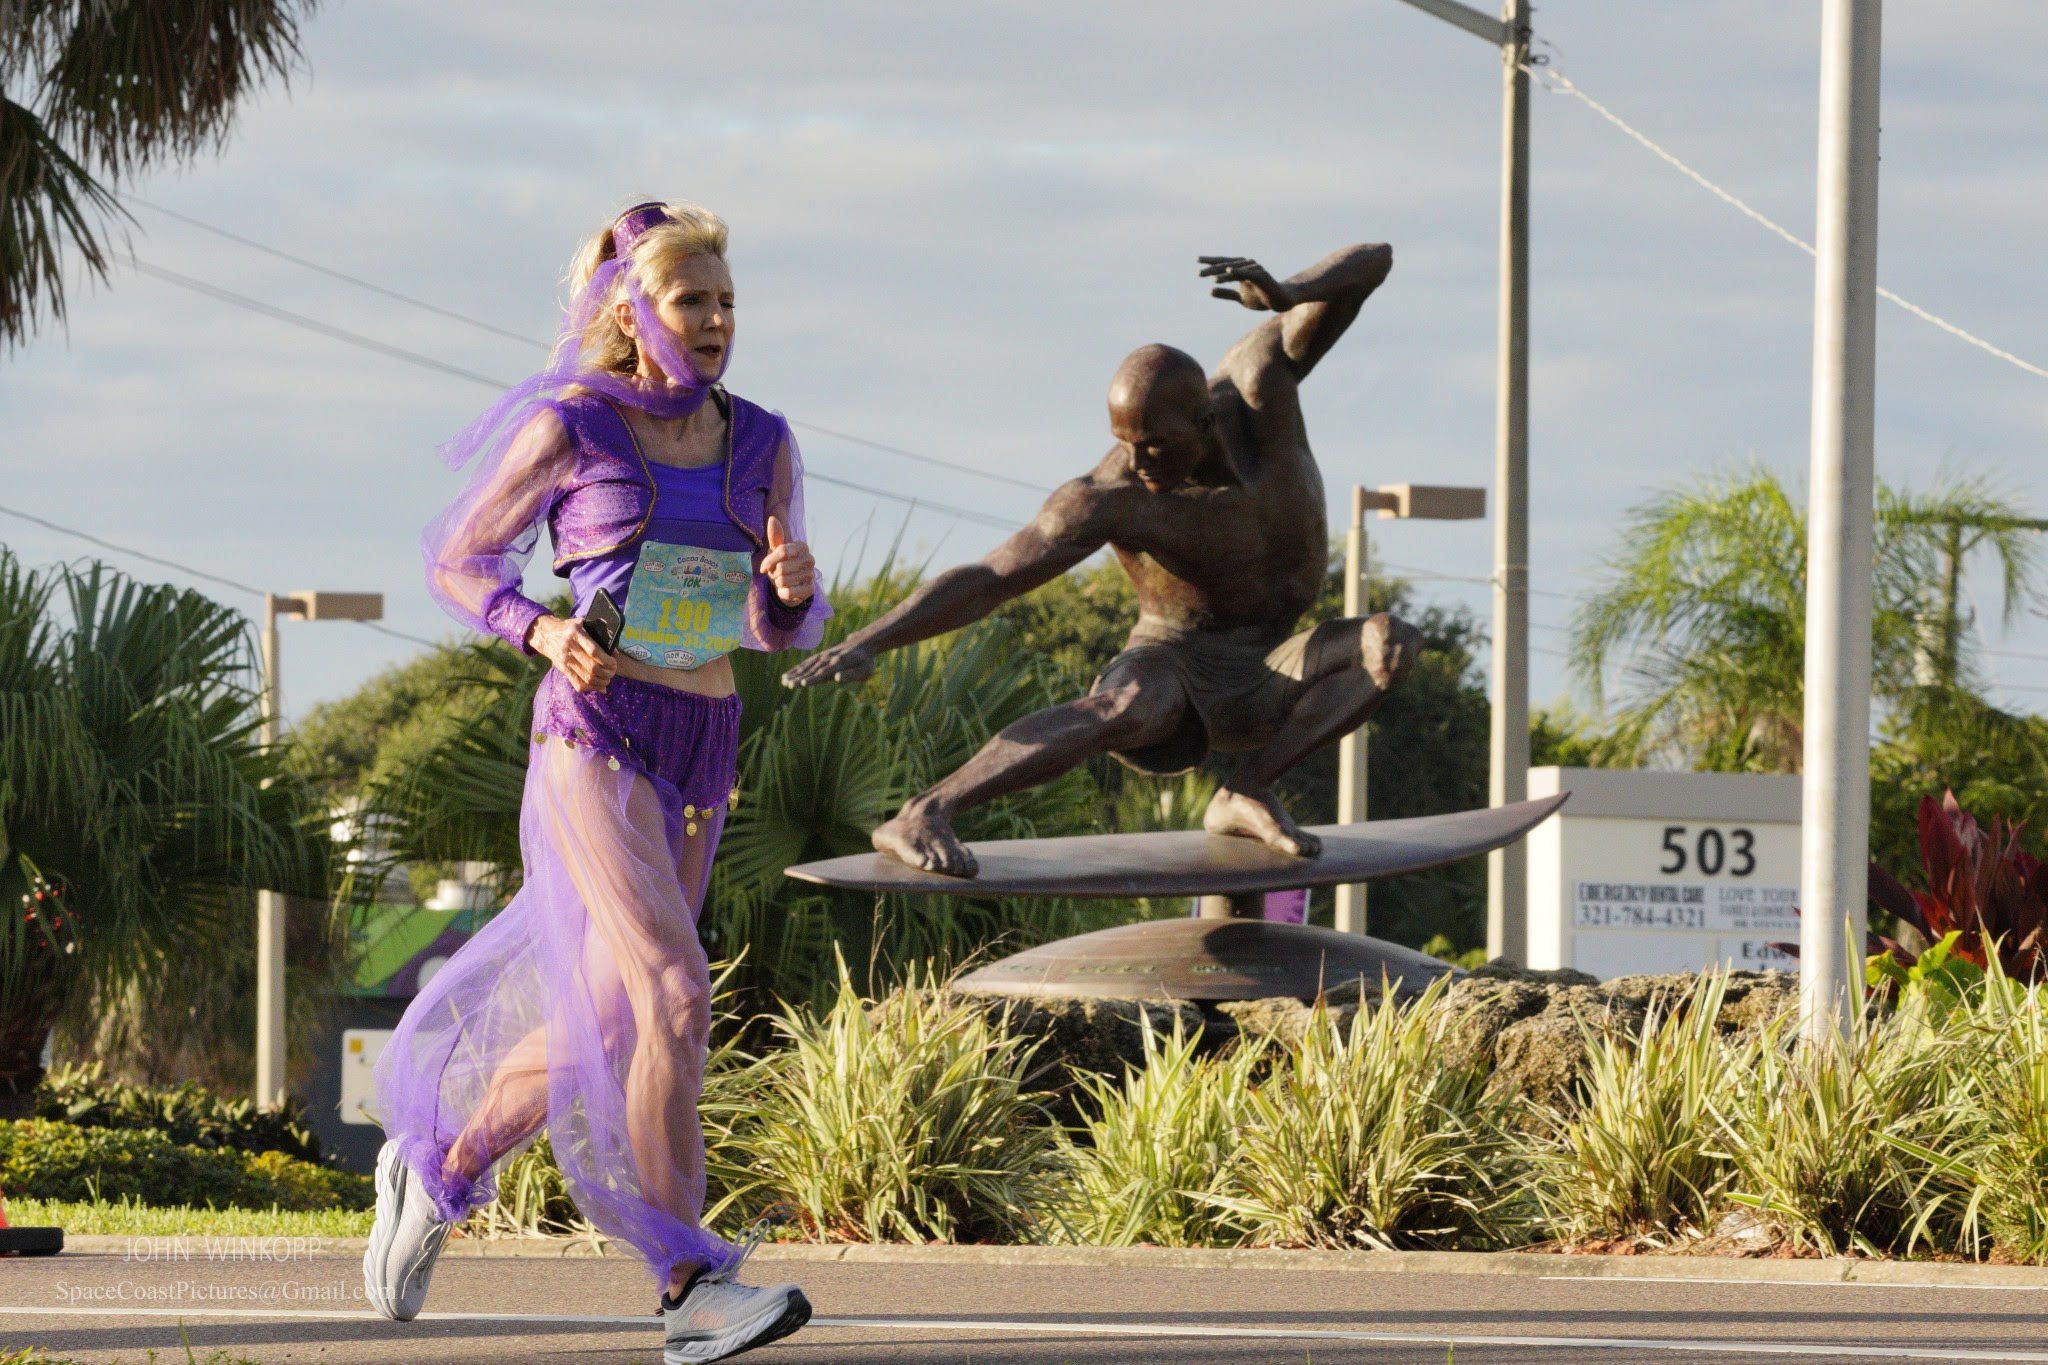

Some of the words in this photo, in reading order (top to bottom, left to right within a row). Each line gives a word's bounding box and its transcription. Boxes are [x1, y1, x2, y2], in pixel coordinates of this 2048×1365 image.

[677, 556, 699, 564] Cocoa
[700, 556, 719, 568] Beach
[683, 577, 701, 588] 10K
[658, 599, 712, 633] 190
[624, 626, 679, 645] October
[626, 649, 649, 658] CARIB
[666, 652, 680, 660] RON
[681, 652, 694, 662] JON
[1660, 827, 1756, 877] 503
[1580, 903, 1705, 928] 321-784-4321
